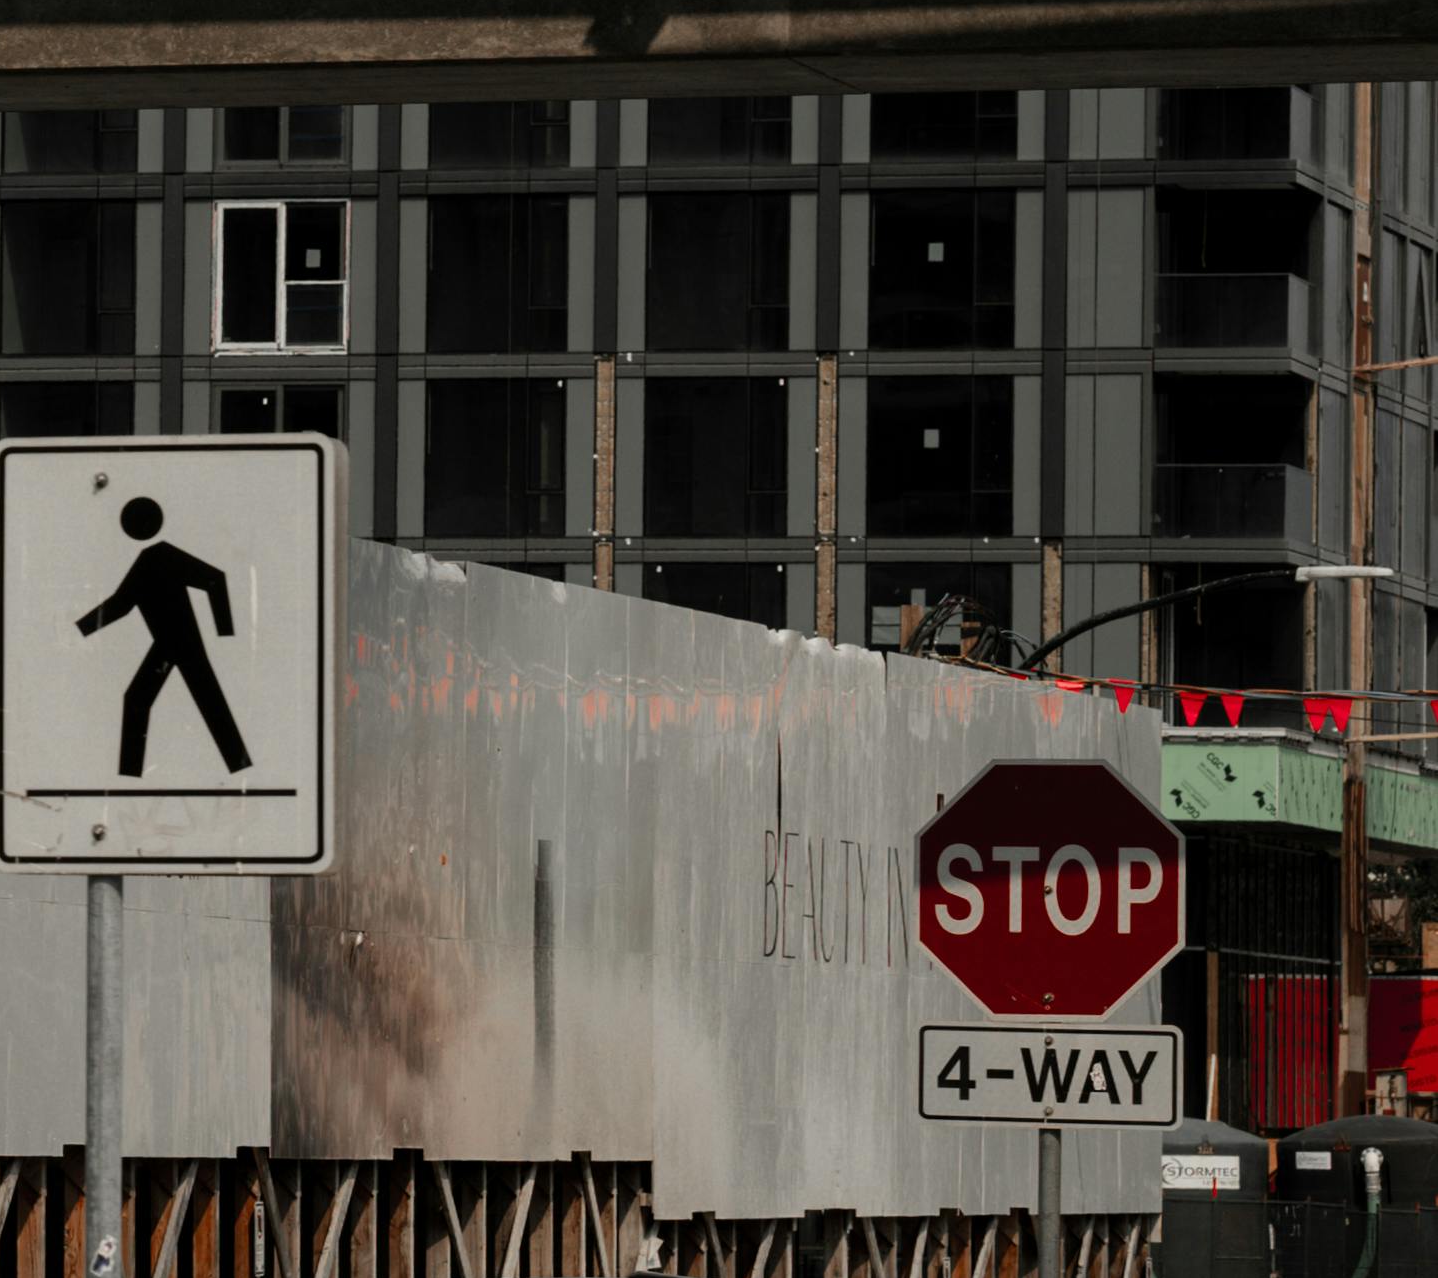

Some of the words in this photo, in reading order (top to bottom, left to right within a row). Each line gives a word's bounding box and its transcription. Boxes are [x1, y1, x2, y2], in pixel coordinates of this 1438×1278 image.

[763, 830, 871, 964] BEAUTY
[934, 843, 1164, 936] STOP
[937, 1045, 1158, 1106] 4-WAY
[1167, 1166, 1238, 1177] STORMTEC
